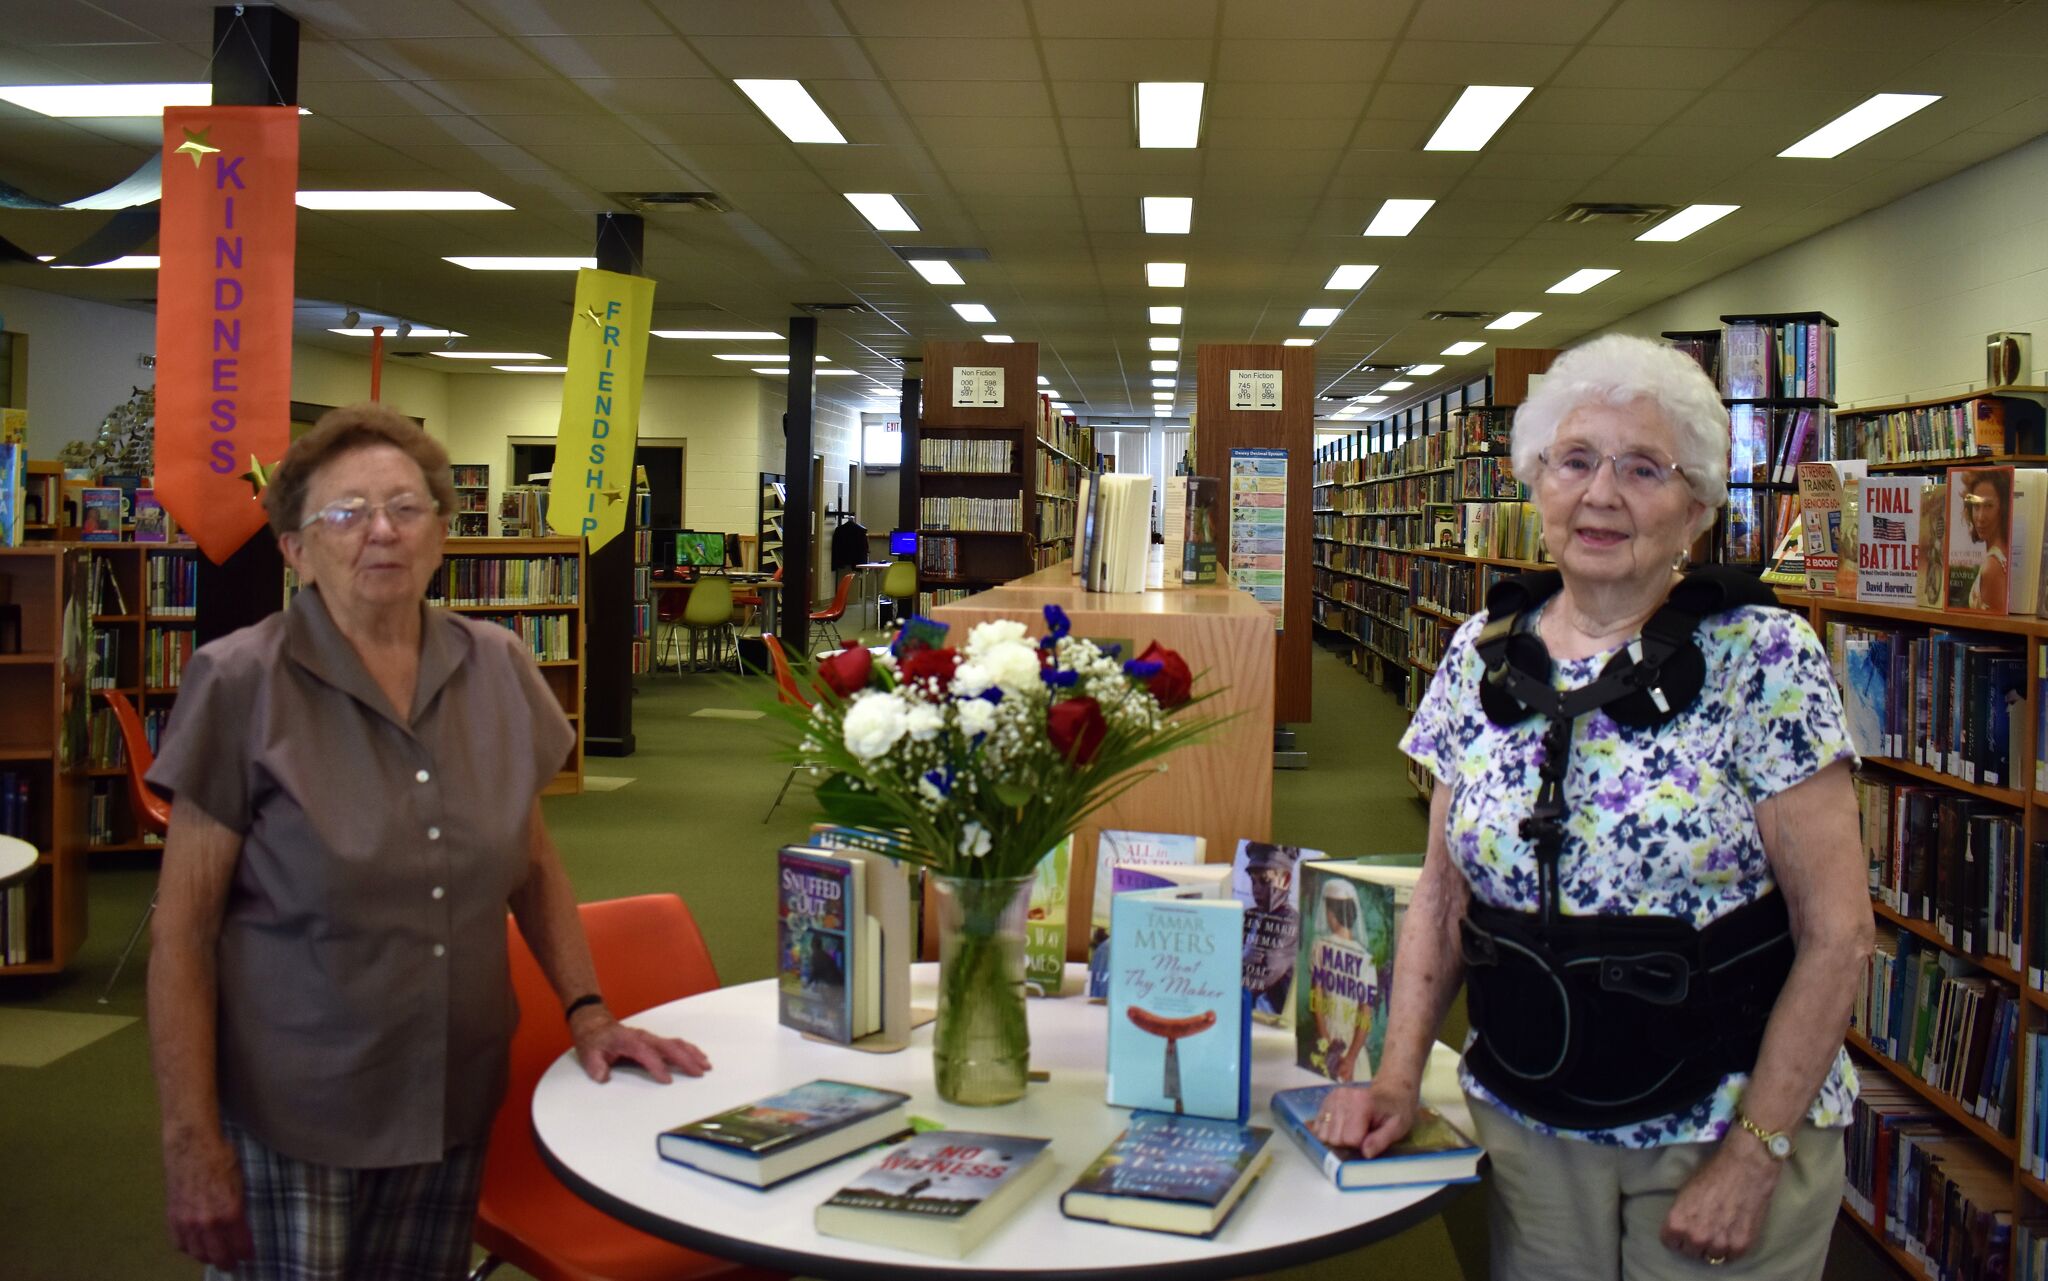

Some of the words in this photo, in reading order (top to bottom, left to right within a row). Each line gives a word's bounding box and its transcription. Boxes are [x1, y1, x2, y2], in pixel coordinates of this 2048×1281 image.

[209, 156, 246, 475] KINDNESS
[582, 301, 621, 538] FRIENDSHIP
[887, 422, 900, 432] EXIT
[1801, 466, 1832, 478] STRENGTH
[1804, 480, 1836, 491] TRAINING
[1804, 499, 1830, 509] SENIORS
[1866, 487, 1913, 513] FINAL
[1806, 559, 1811, 567] 2
[1859, 543, 1920, 570] BATTLE
[1866, 581, 1883, 592] David
[1884, 582, 1913, 593] Horowitz
[1127, 843, 1152, 857] ALL
[782, 868, 841, 900] SNUFFED
[796, 893, 826, 916] OUT
[1148, 914, 1204, 932] TAMAR
[1135, 929, 1216, 953] MYERS
[1322, 945, 1364, 978] MARY
[1125, 969, 1155, 999] Thy
[1160, 975, 1225, 998] Maker
[1312, 965, 1378, 1008] MONROE
[937, 1144, 985, 1160] NO
[879, 1153, 1009, 1179] WITNESS
